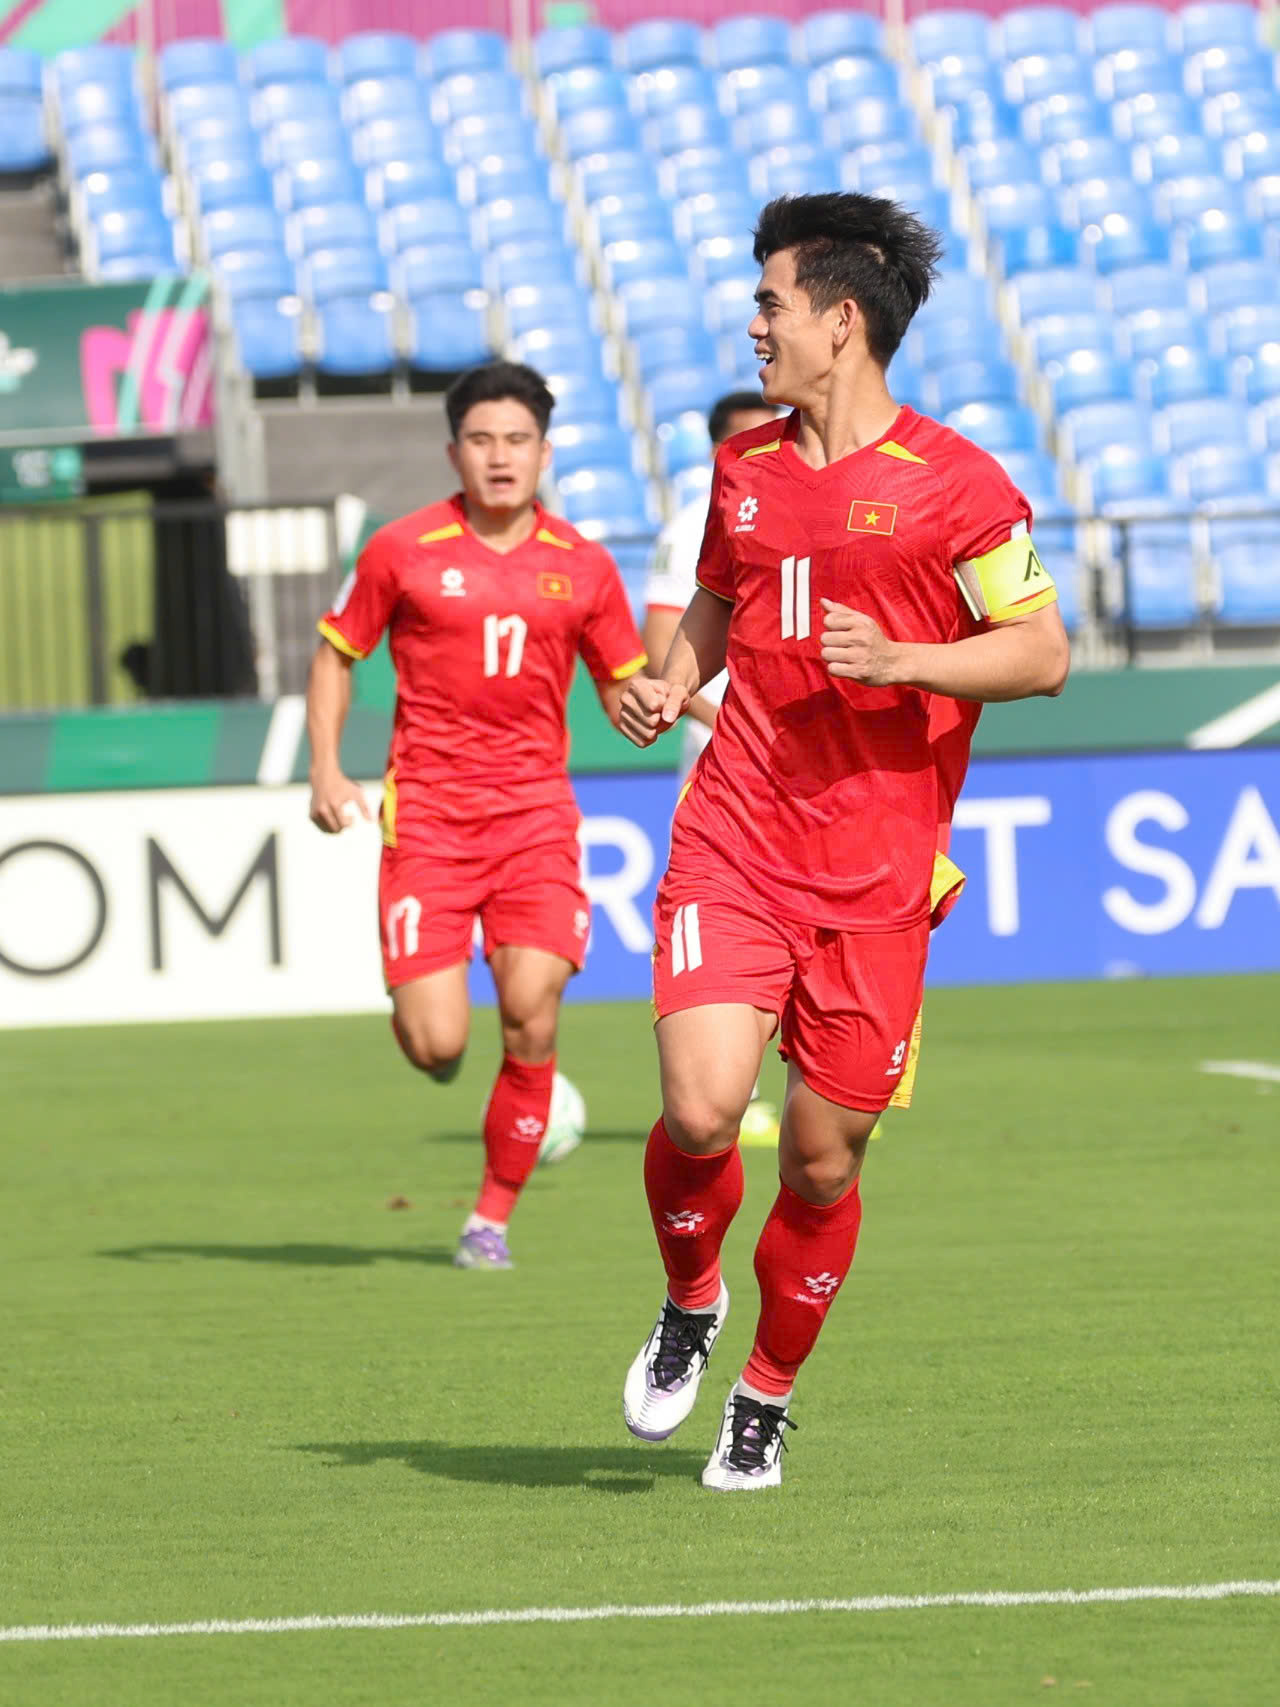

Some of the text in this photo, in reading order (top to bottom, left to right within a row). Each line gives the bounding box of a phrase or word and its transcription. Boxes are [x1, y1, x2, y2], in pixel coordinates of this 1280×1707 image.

[781, 554, 811, 641] 11
[483, 614, 528, 679] 17
[386, 895, 421, 960] 17
[671, 903, 703, 978] 11
